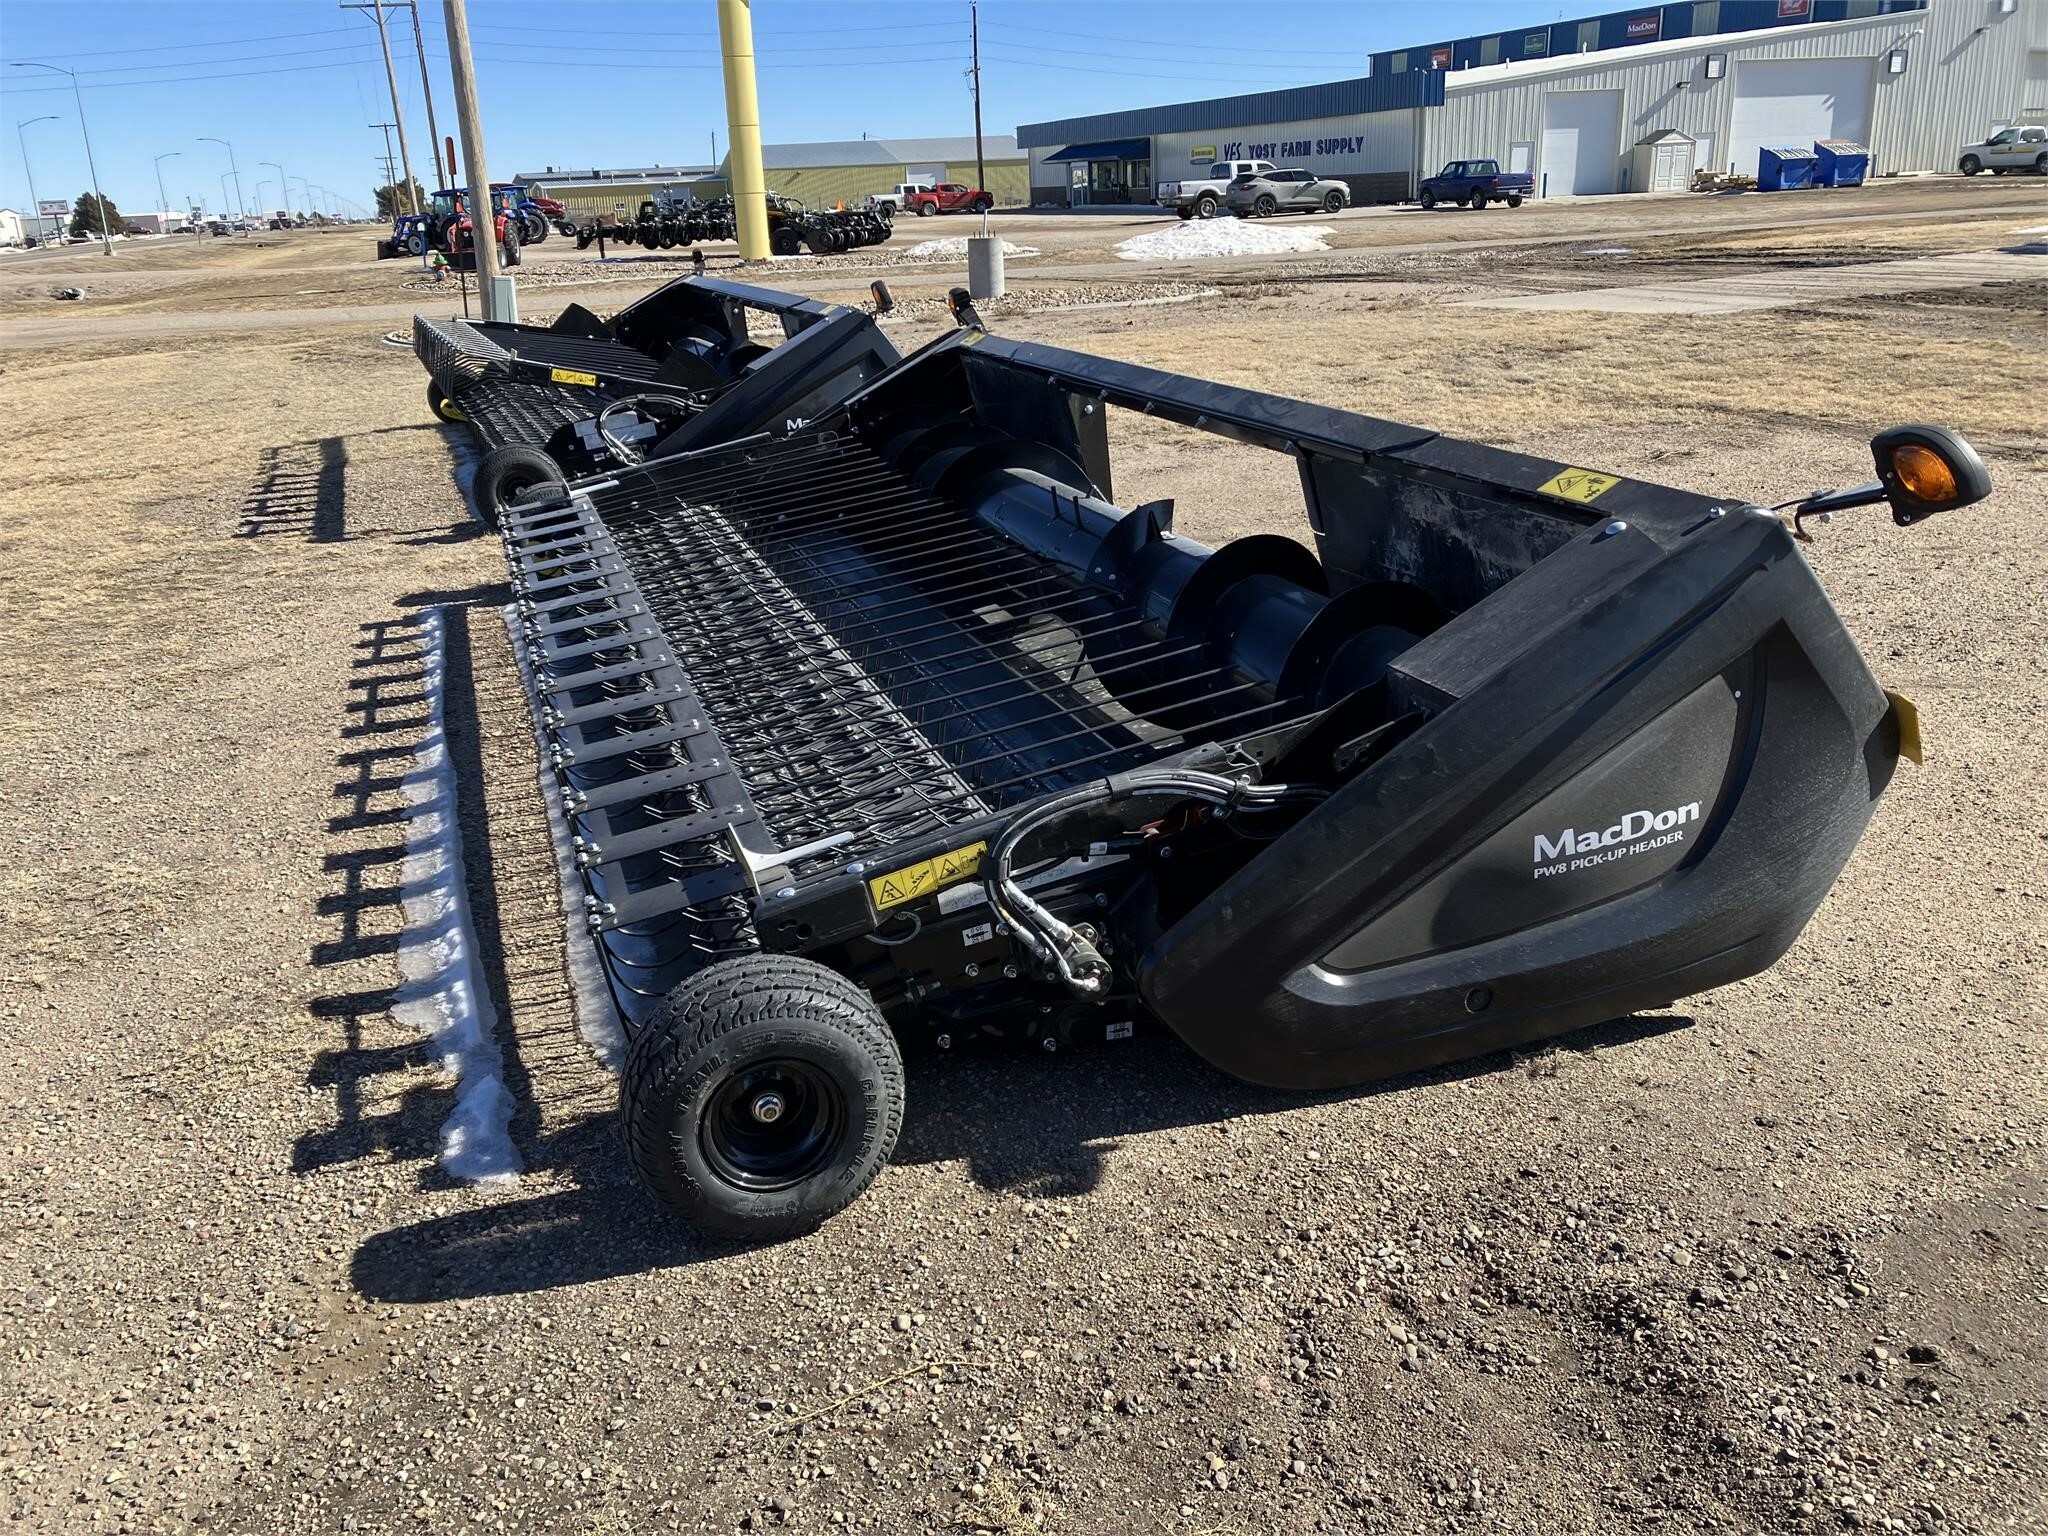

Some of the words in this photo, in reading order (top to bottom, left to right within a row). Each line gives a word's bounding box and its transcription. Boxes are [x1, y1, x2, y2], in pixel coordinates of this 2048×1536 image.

[1628, 22, 1657, 32] MacDon
[1249, 143, 1277, 159] YOST
[1281, 140, 1312, 158] FARM
[1316, 136, 1364, 155] SUPPLY
[1533, 801, 1702, 863] MacDon
[1533, 862, 1568, 879] PW8
[1570, 847, 1627, 871] PICK-UP
[1629, 830, 1684, 855] HEADER
[675, 1055, 728, 1114] TRAIL
[839, 1078, 880, 1182] CARLISLE
